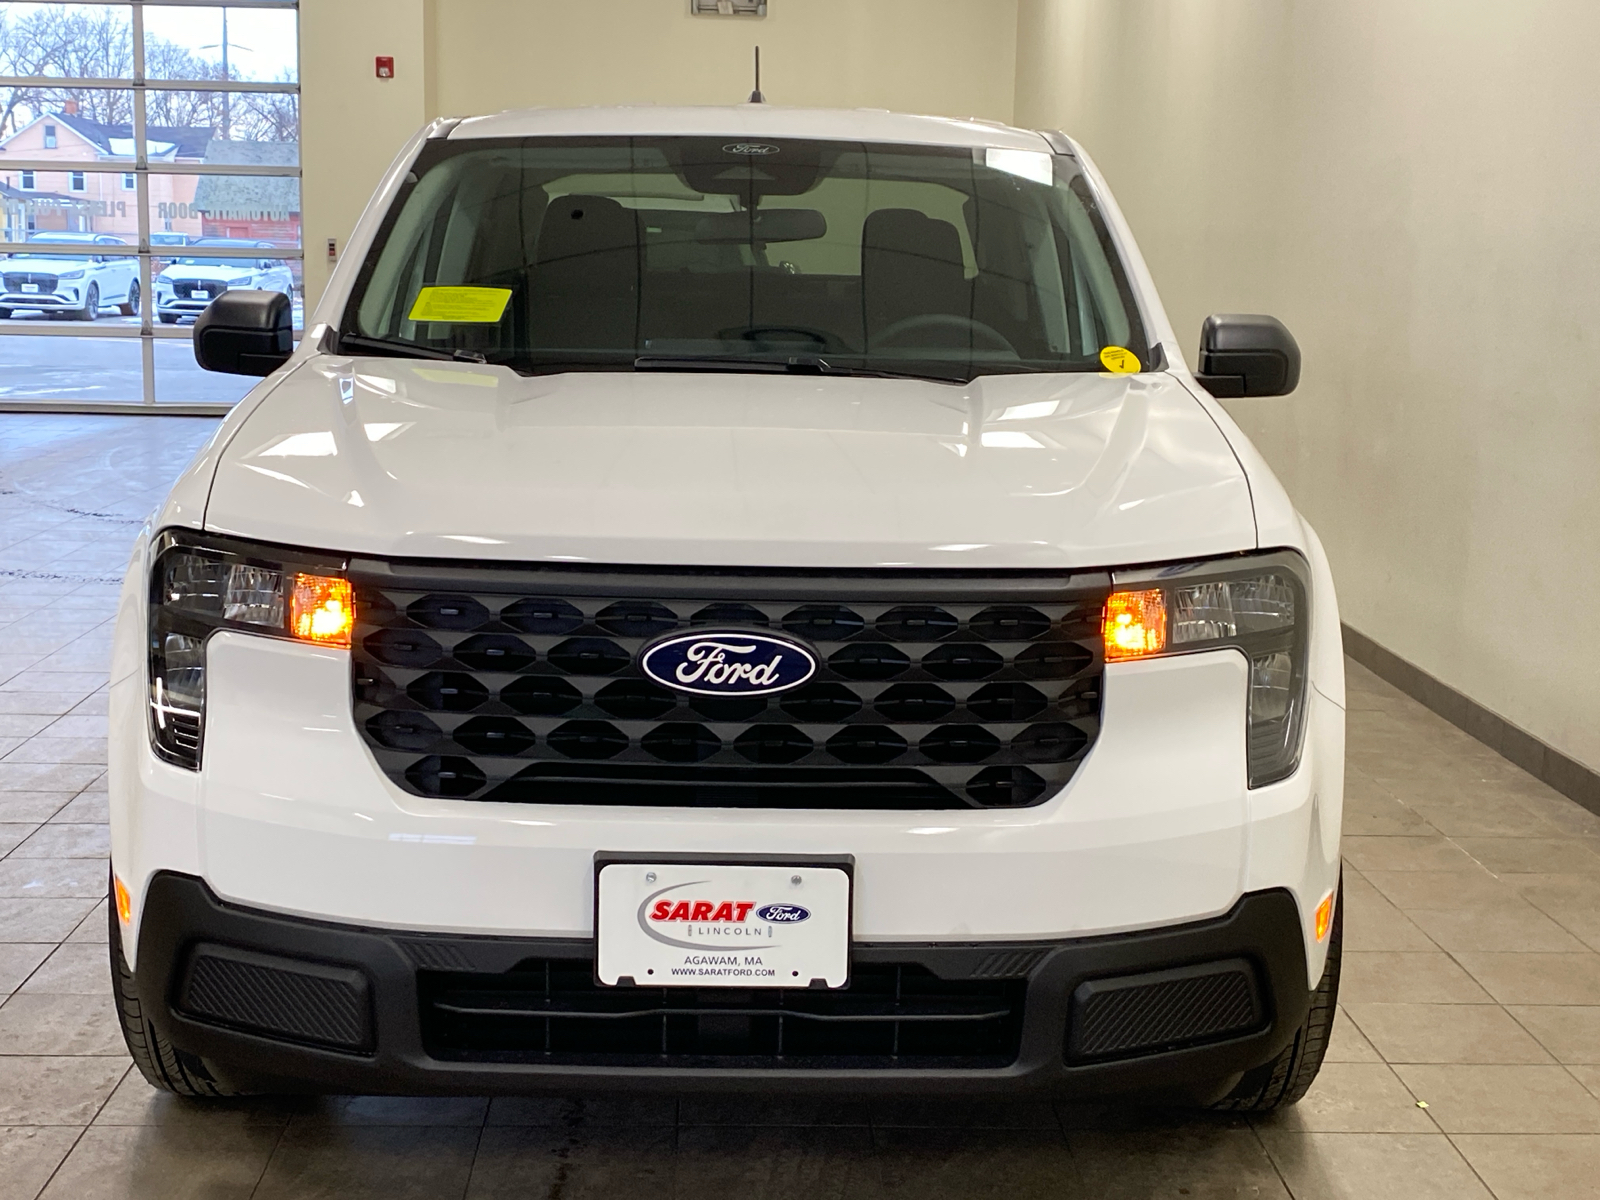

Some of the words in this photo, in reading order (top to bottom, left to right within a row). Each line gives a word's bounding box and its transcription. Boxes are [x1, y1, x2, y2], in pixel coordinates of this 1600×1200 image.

[675, 641, 783, 686] Ford
[649, 900, 757, 924] SARAT
[765, 905, 801, 922] Ford
[698, 926, 763, 937] LINCOLN
[683, 956, 742, 967] AGAWAM,
[744, 957, 764, 967] MA
[671, 967, 776, 978] WWW.SARATFORD.COM
